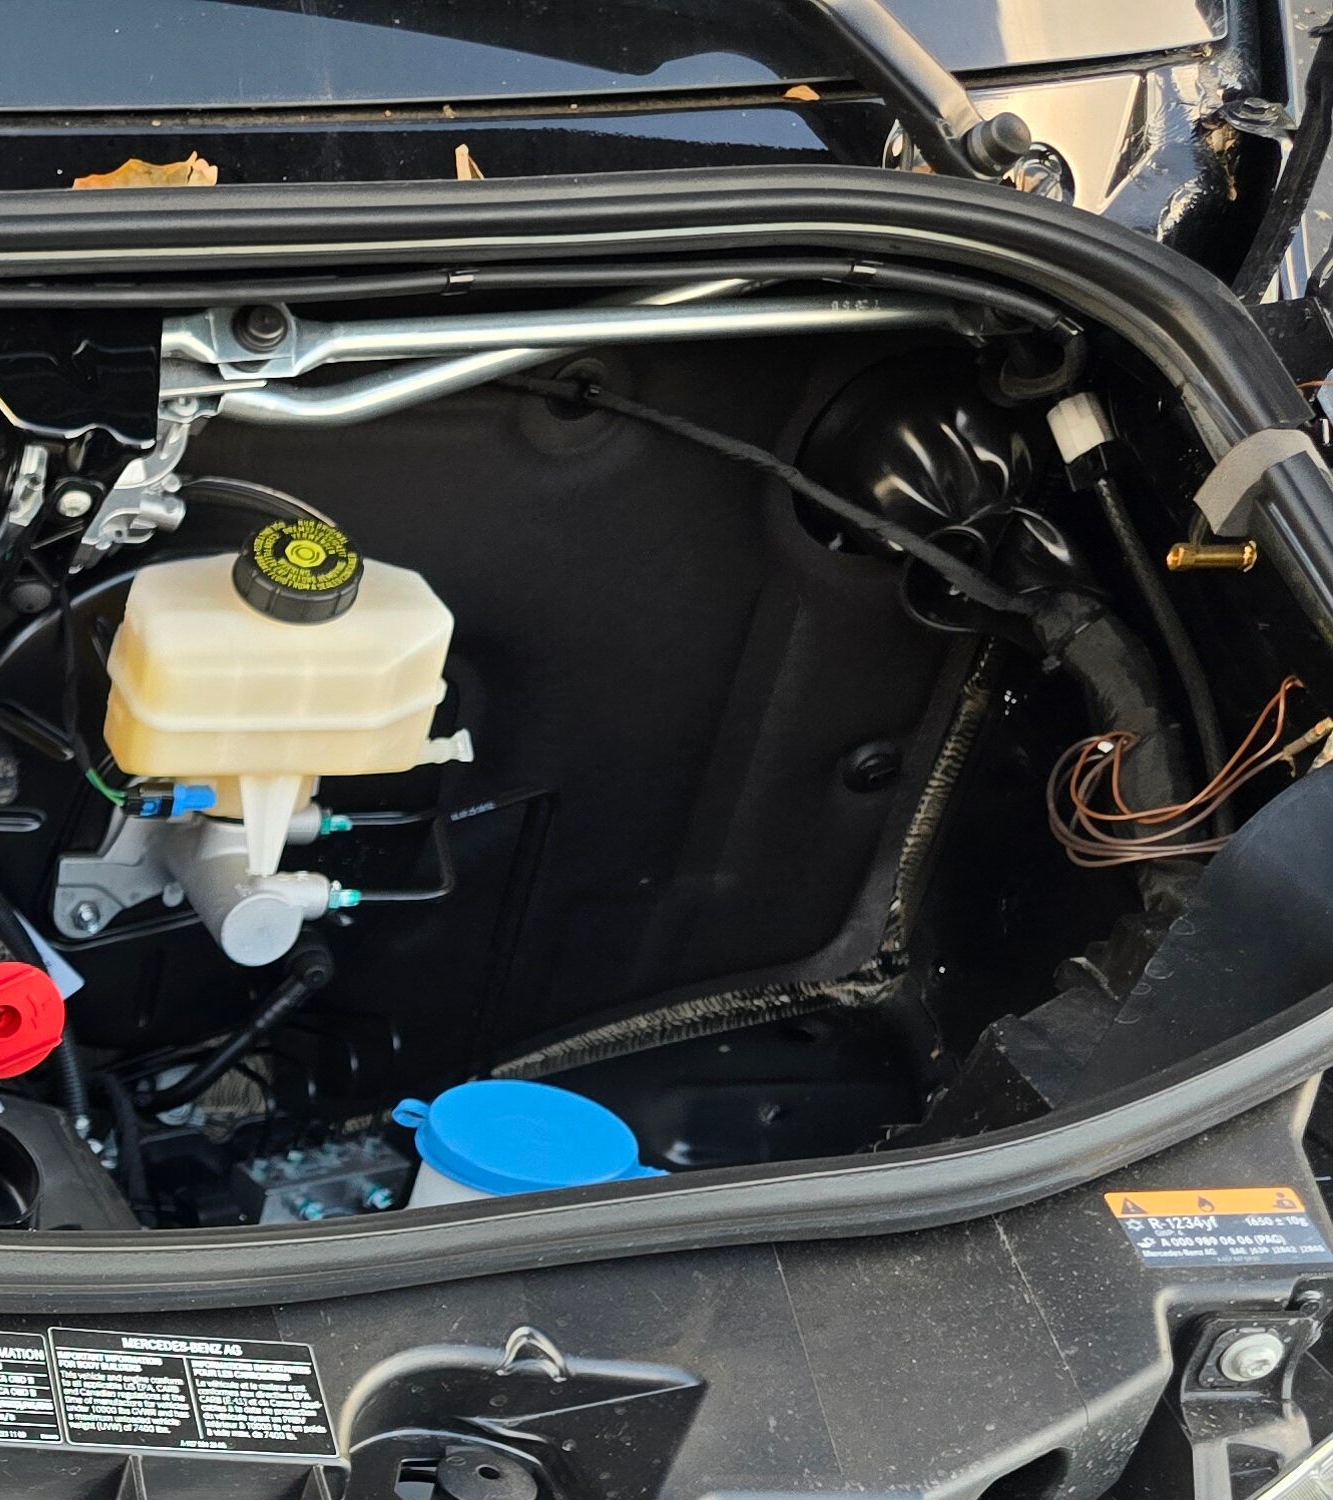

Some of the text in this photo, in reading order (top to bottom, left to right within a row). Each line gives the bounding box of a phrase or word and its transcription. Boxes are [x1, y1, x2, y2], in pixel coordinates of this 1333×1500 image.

[1148, 1216, 1218, 1231] R-1234yf
[1161, 1237, 1171, 1246] A
[1172, 1237, 1194, 1246] 000
[1237, 1236, 1253, 1245] 06
[1142, 1249, 1204, 1257] Mercedes-Benz
[121, 1337, 243, 1356] MERCEDES-BENZ AG
